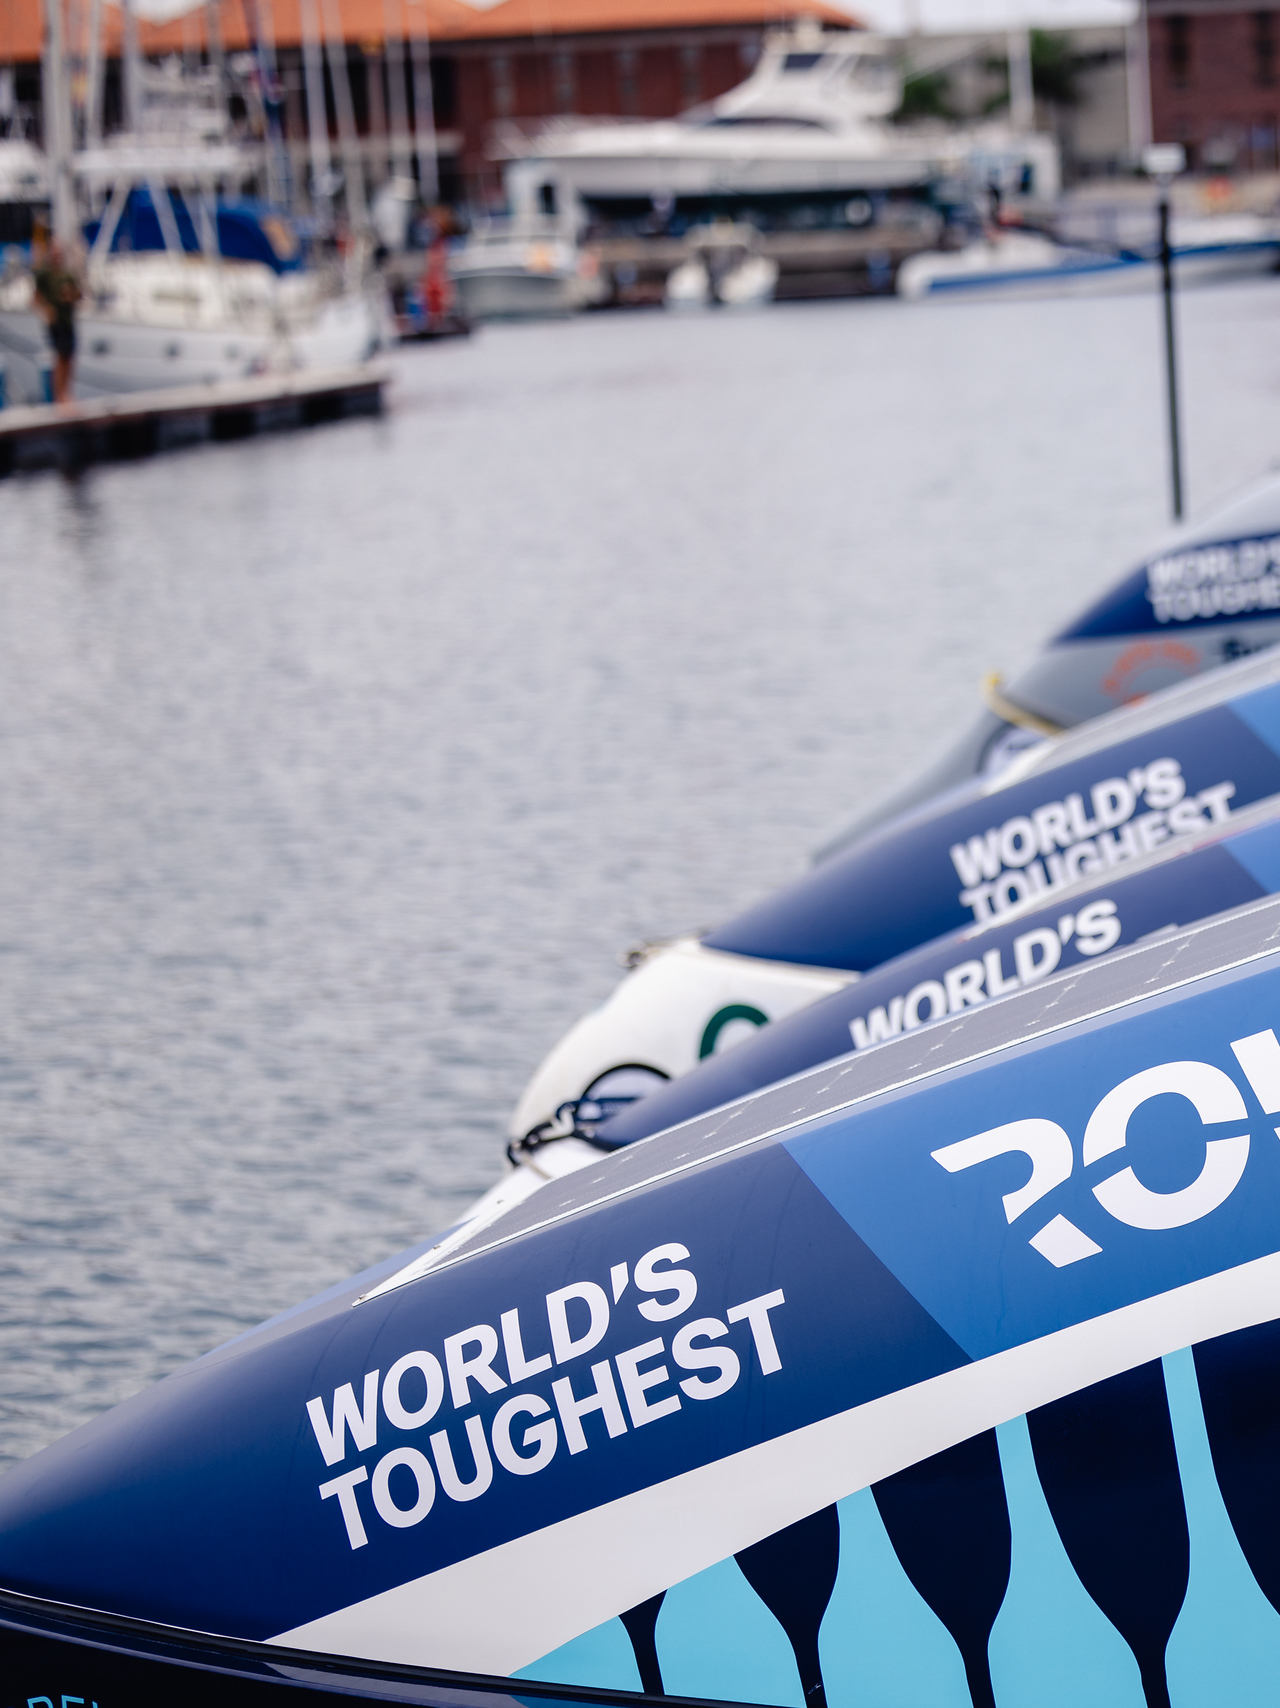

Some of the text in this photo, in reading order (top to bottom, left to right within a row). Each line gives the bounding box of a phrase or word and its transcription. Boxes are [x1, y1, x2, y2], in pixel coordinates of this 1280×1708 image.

[949, 757, 1187, 889] WORLD'S
[847, 899, 1123, 1049] WORLD'S
[306, 1242, 699, 1467] WORLD'S
[318, 1288, 786, 1551] TOUGHEST
